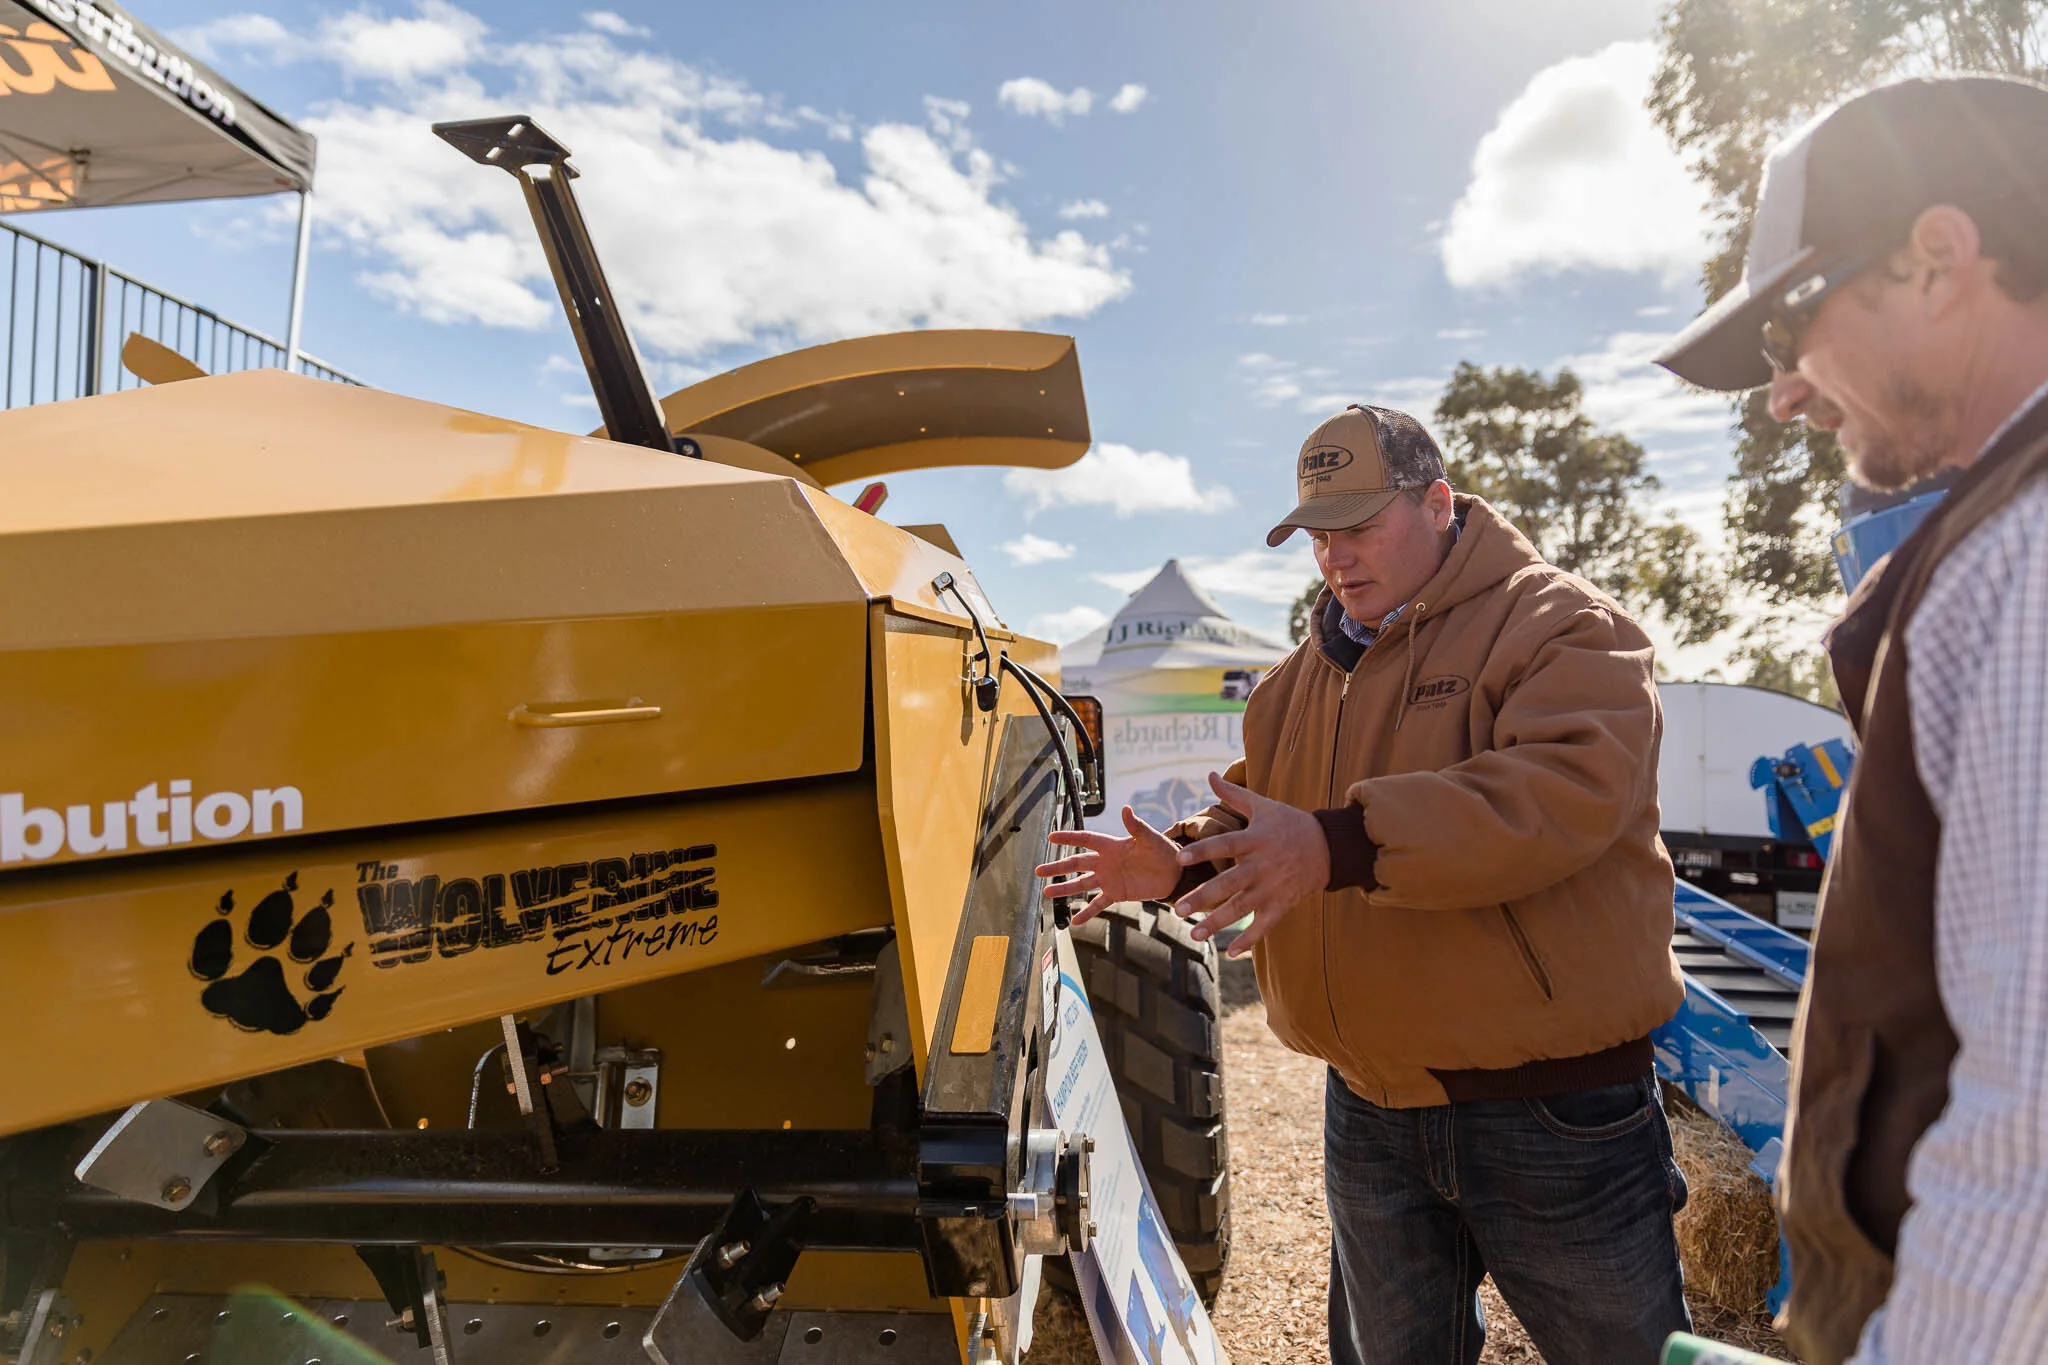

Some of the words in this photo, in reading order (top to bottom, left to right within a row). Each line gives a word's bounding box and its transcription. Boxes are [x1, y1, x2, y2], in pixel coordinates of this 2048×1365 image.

[0, 779, 304, 863] bution
[356, 860, 399, 883] The
[356, 844, 720, 968] WOLVERINE
[546, 915, 719, 976] Extreme
